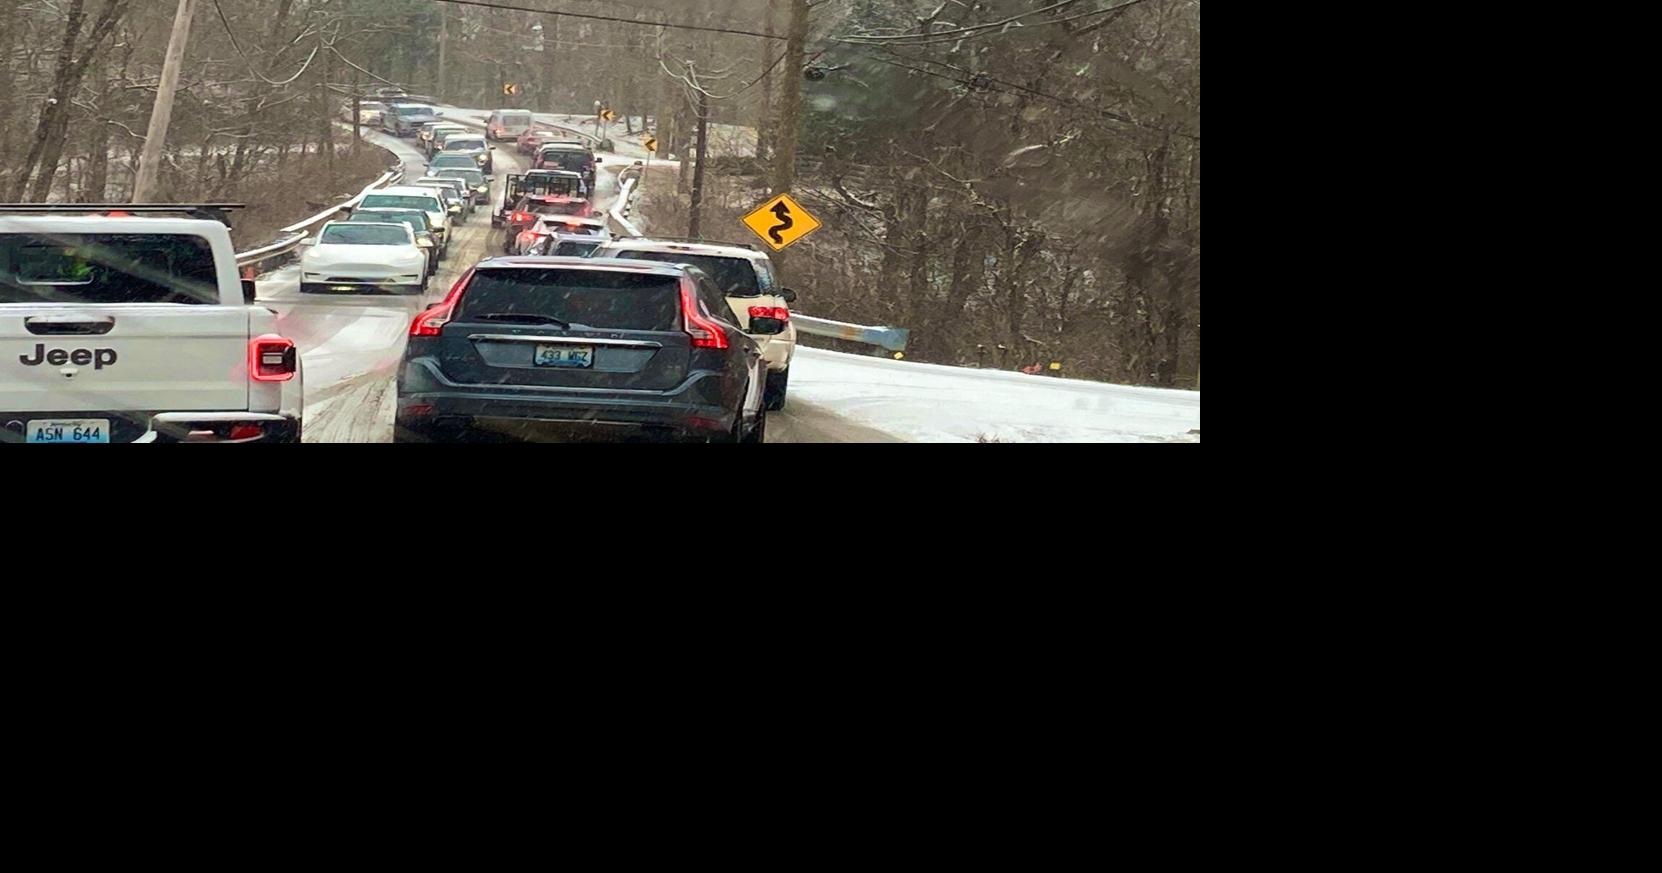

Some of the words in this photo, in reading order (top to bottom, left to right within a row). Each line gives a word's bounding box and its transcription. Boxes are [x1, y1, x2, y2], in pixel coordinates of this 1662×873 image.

[19, 343, 118, 370] Jeep
[540, 350, 561, 361] 433
[35, 426, 64, 441] ASN
[72, 426, 100, 441] 644
